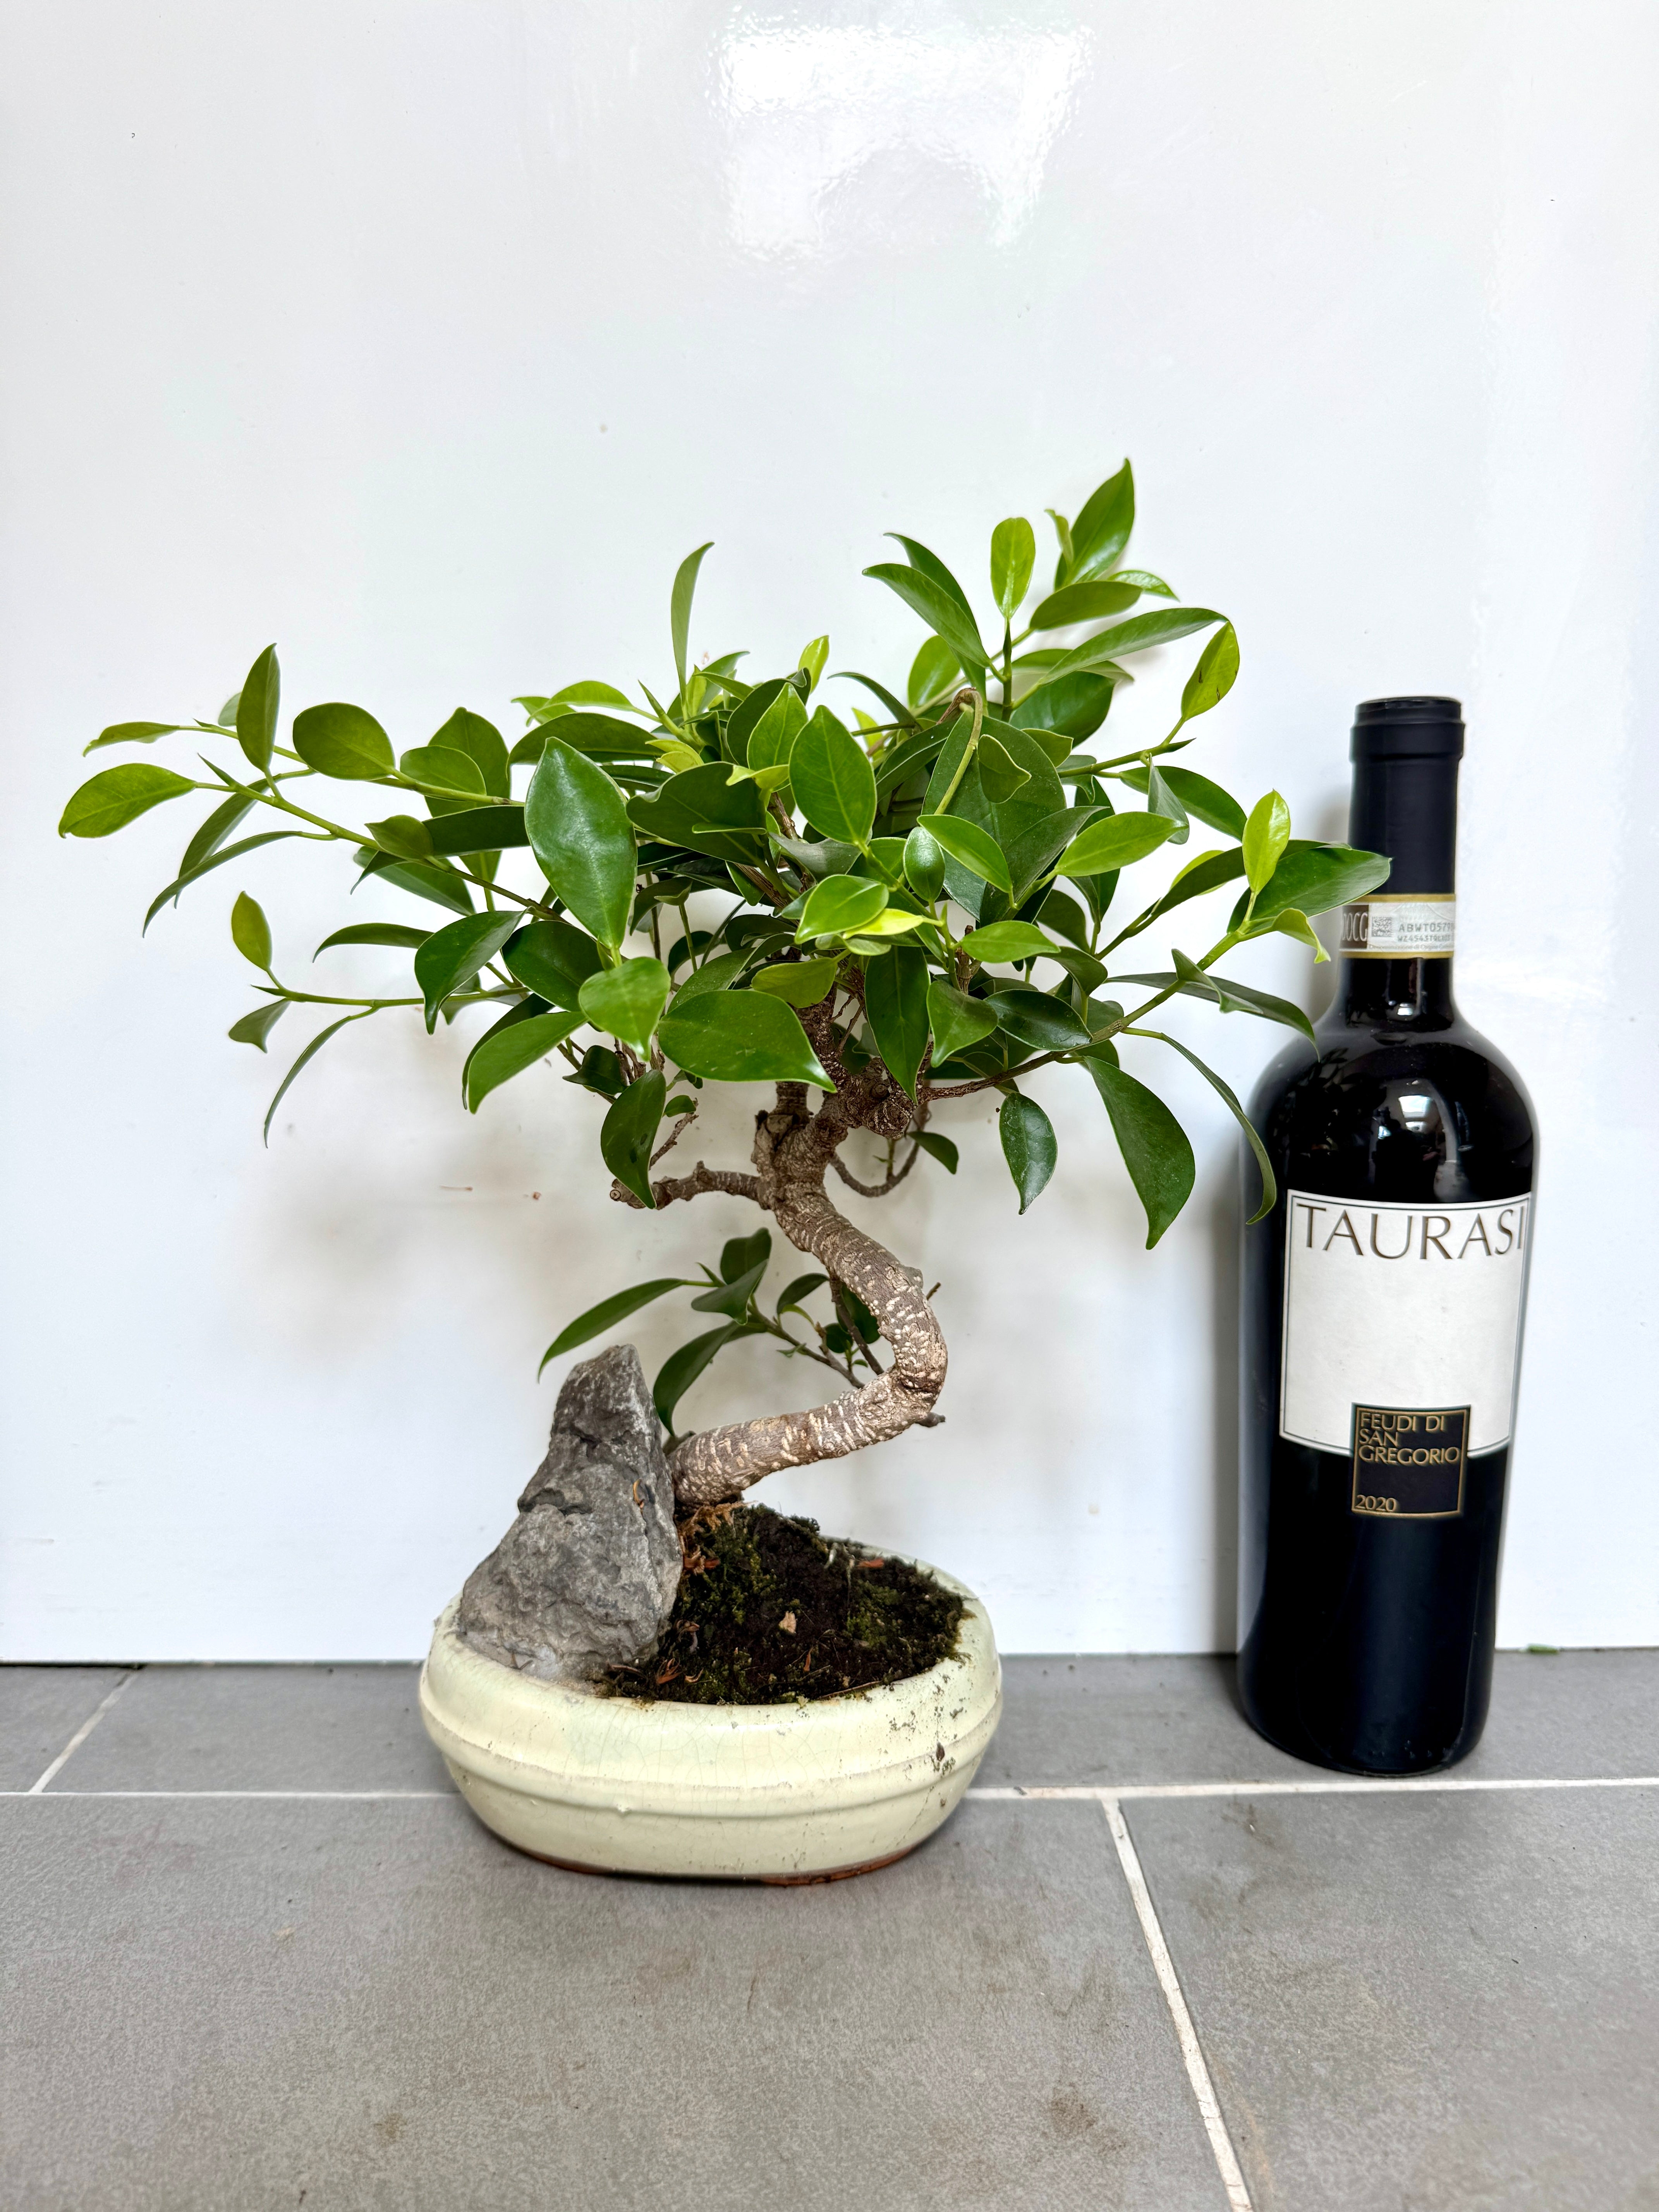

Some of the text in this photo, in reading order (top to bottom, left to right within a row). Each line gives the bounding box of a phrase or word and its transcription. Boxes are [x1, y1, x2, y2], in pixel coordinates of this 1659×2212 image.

[1296, 1203, 1525, 1259] TAURASI
[1360, 1412, 1445, 1432] FEUDI DI
[1358, 1428, 1399, 1447] SAN
[1358, 1445, 1460, 1466] GREGORIO
[1355, 1494, 1397, 1512] 2020
